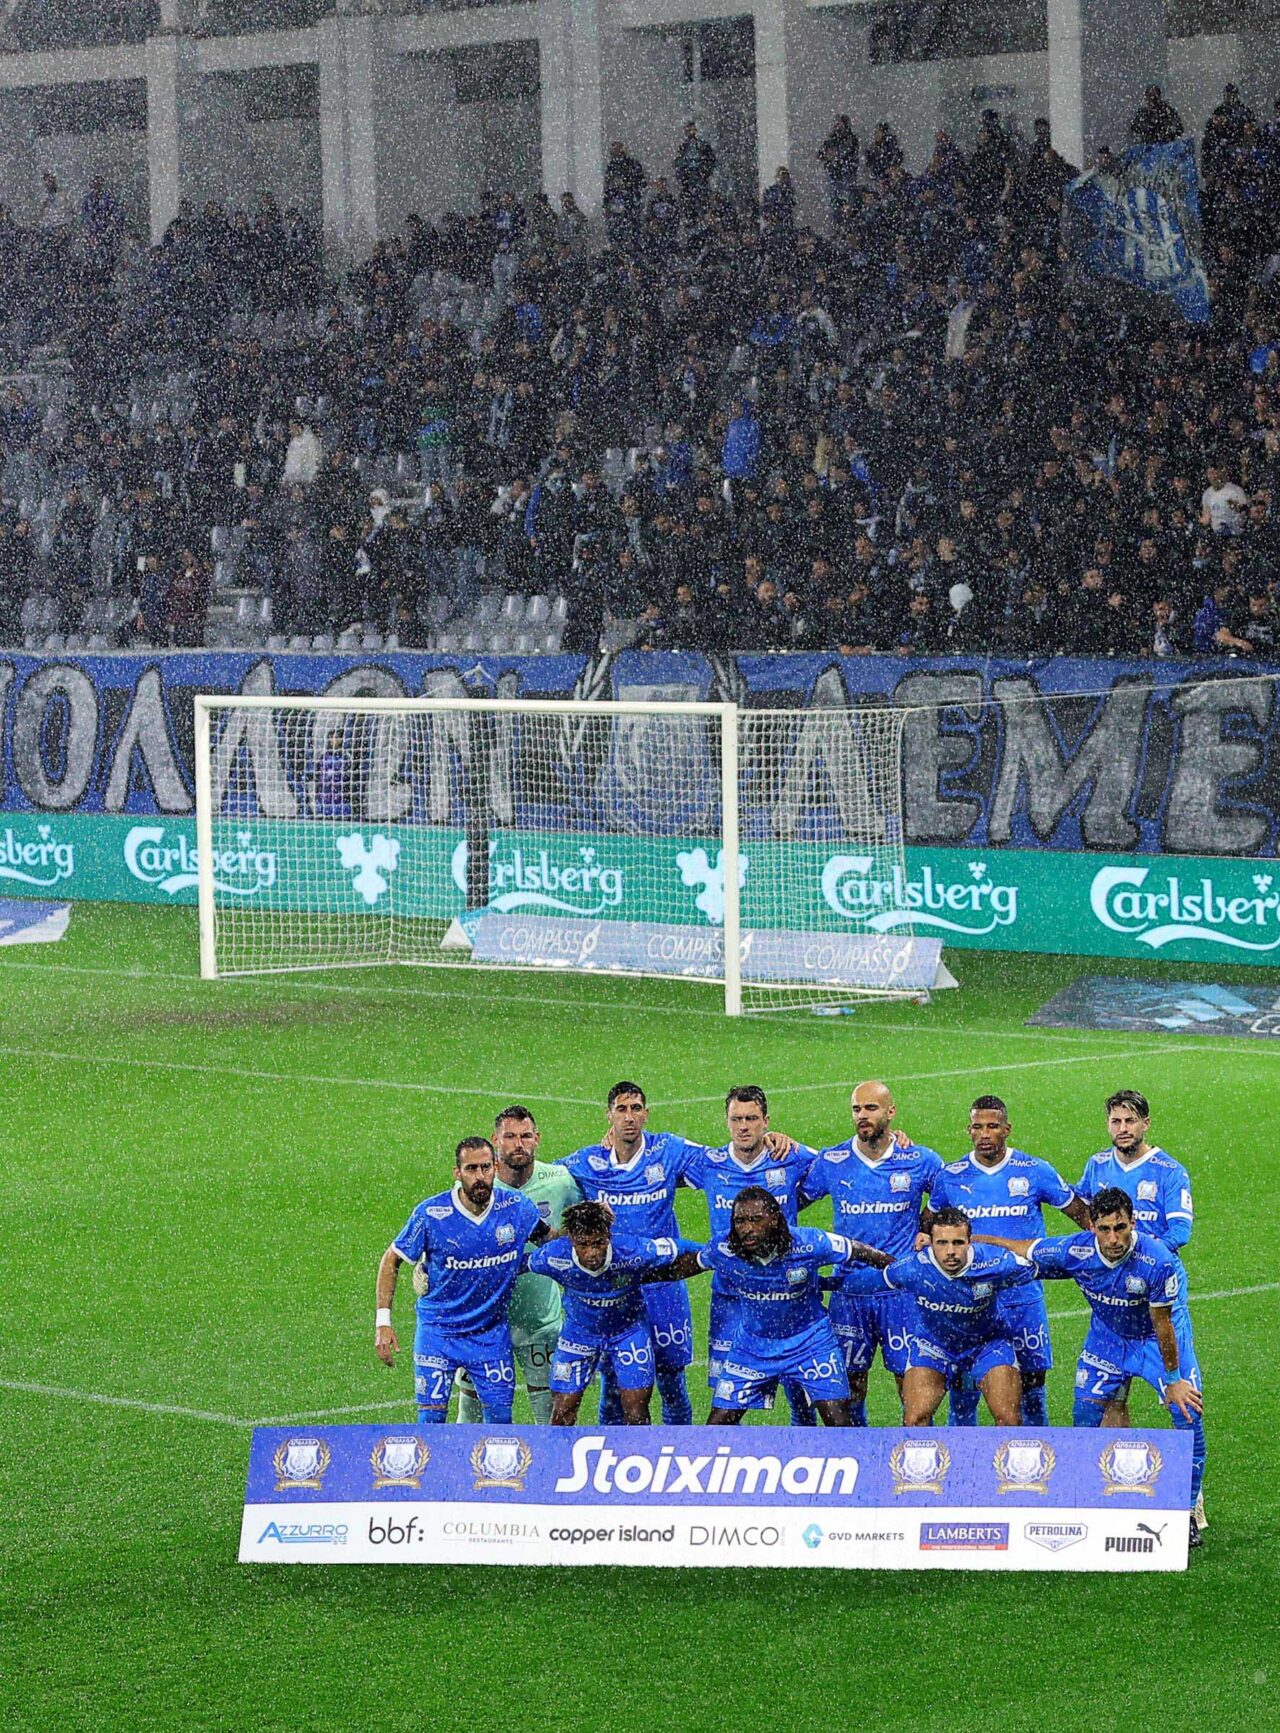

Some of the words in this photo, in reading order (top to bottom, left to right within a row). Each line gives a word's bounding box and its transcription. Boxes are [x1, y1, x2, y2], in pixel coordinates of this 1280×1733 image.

[0, 655, 520, 822] ΟΛΛΩΝ
[124, 826, 276, 892] Carlserg
[821, 855, 1018, 931] Carlsberg
[647, 934, 727, 962] COMPAS
[1008, 1158, 1039, 1168] DIMCO
[493, 1195, 522, 1211] DIMCO
[596, 1188, 668, 1206] Stoiximan
[840, 1200, 911, 1215] Stoiximan
[783, 1243, 814, 1255] IMCO
[445, 1250, 518, 1270] Stoiximan
[609, 1256, 642, 1271] DIMCO
[970, 1258, 1000, 1271] DIMCO
[843, 1339, 867, 1368] 14
[1091, 1370, 1109, 1395] 2
[555, 1436, 860, 1494] Stoiximan
[256, 1521, 349, 1544] AZZURRO
[443, 1521, 541, 1538] COLUMBIA
[549, 1527, 615, 1544] copper
[618, 1525, 675, 1542] island
[689, 1526, 780, 1546] DIMCO
[828, 1532, 852, 1541] GVD
[855, 1532, 905, 1541] MARKETS
[928, 1527, 1002, 1541] LAMBERTS
[1029, 1525, 1083, 1536] PETROLINA
[1104, 1536, 1154, 1553] PUMA
